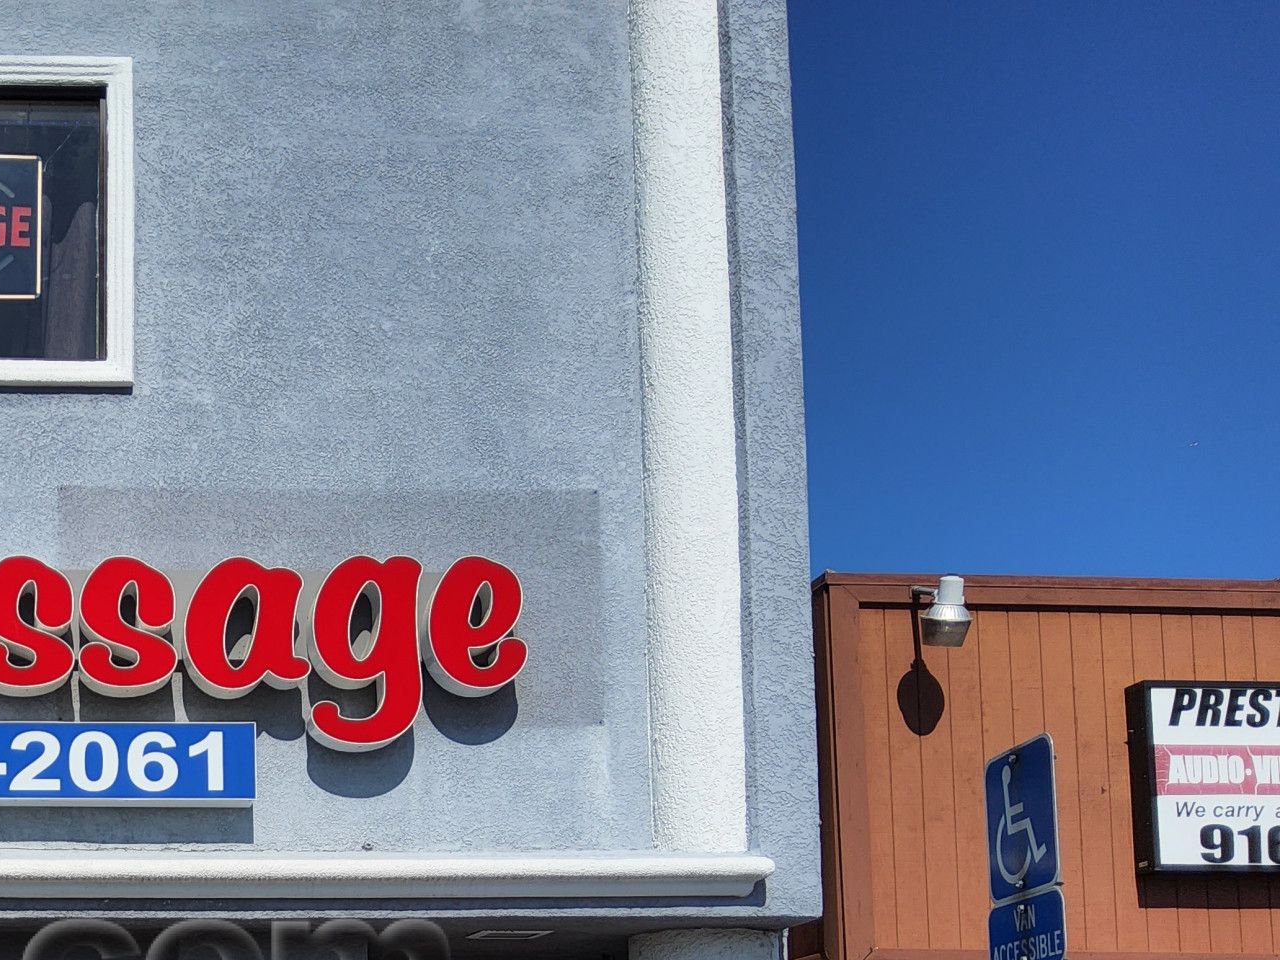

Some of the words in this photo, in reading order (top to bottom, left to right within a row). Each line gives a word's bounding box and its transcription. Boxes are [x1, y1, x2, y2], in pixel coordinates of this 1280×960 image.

[1176, 802, 1206, 817] We
[1213, 803, 1264, 821] carry
[1013, 904, 1036, 932] VAN
